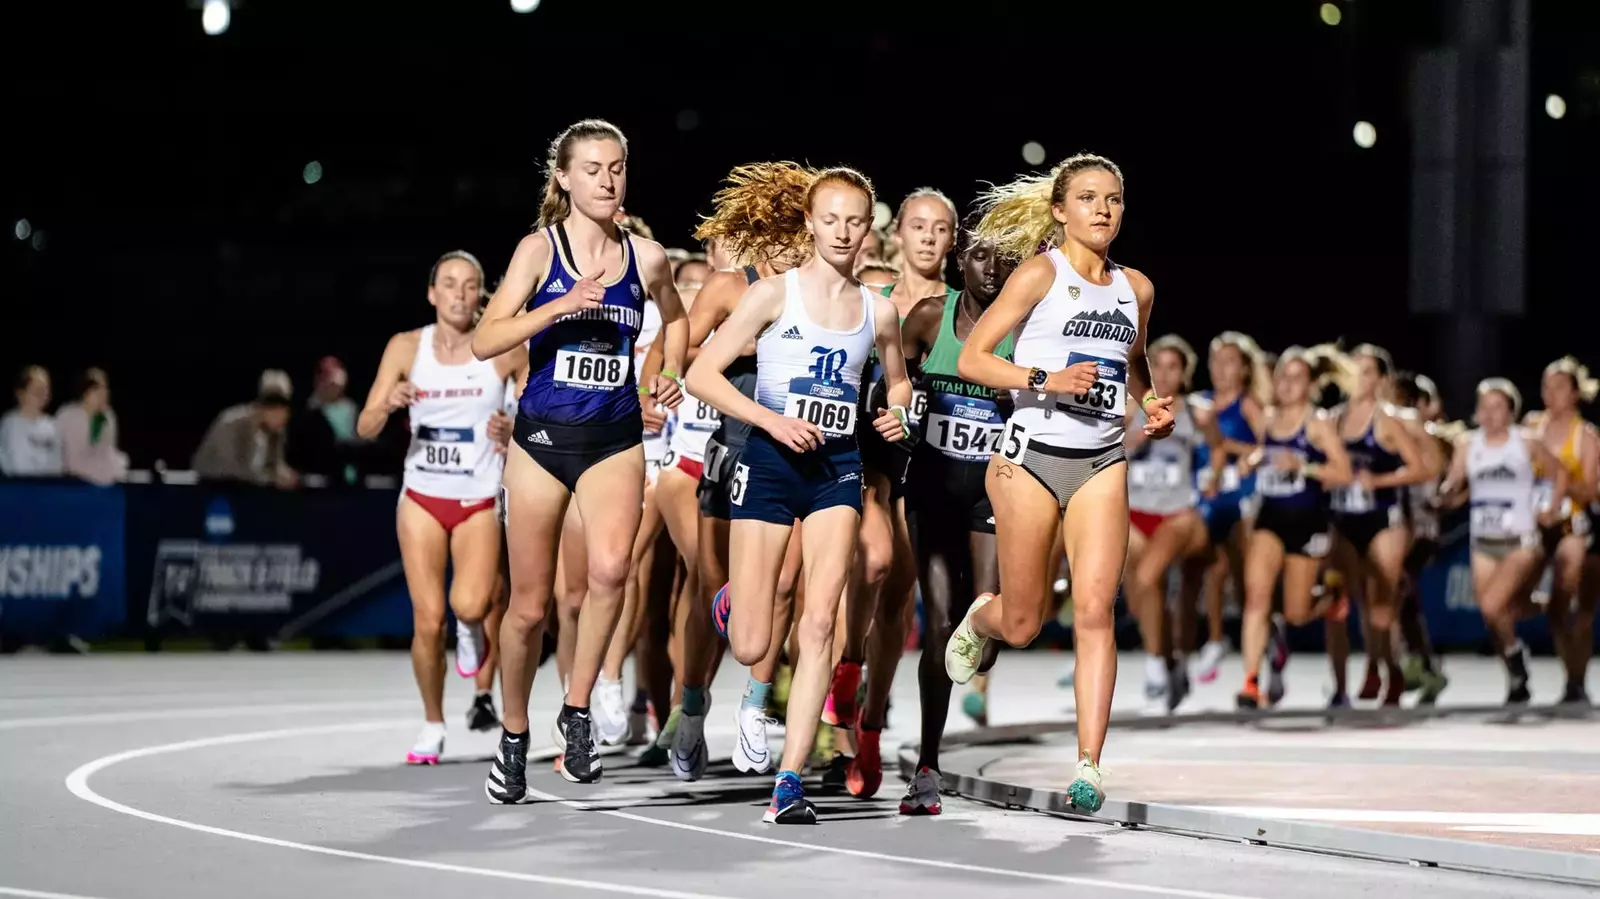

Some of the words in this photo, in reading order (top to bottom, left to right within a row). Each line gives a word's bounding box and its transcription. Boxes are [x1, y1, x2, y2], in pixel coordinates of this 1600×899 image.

[554, 303, 641, 331] SHINGTON
[1062, 320, 1137, 345] COLORADO
[566, 355, 621, 383] 1608
[932, 380, 963, 394] UTAH
[796, 399, 850, 431] 1069
[426, 444, 462, 465] 804
[1005, 423, 1026, 459] 5
